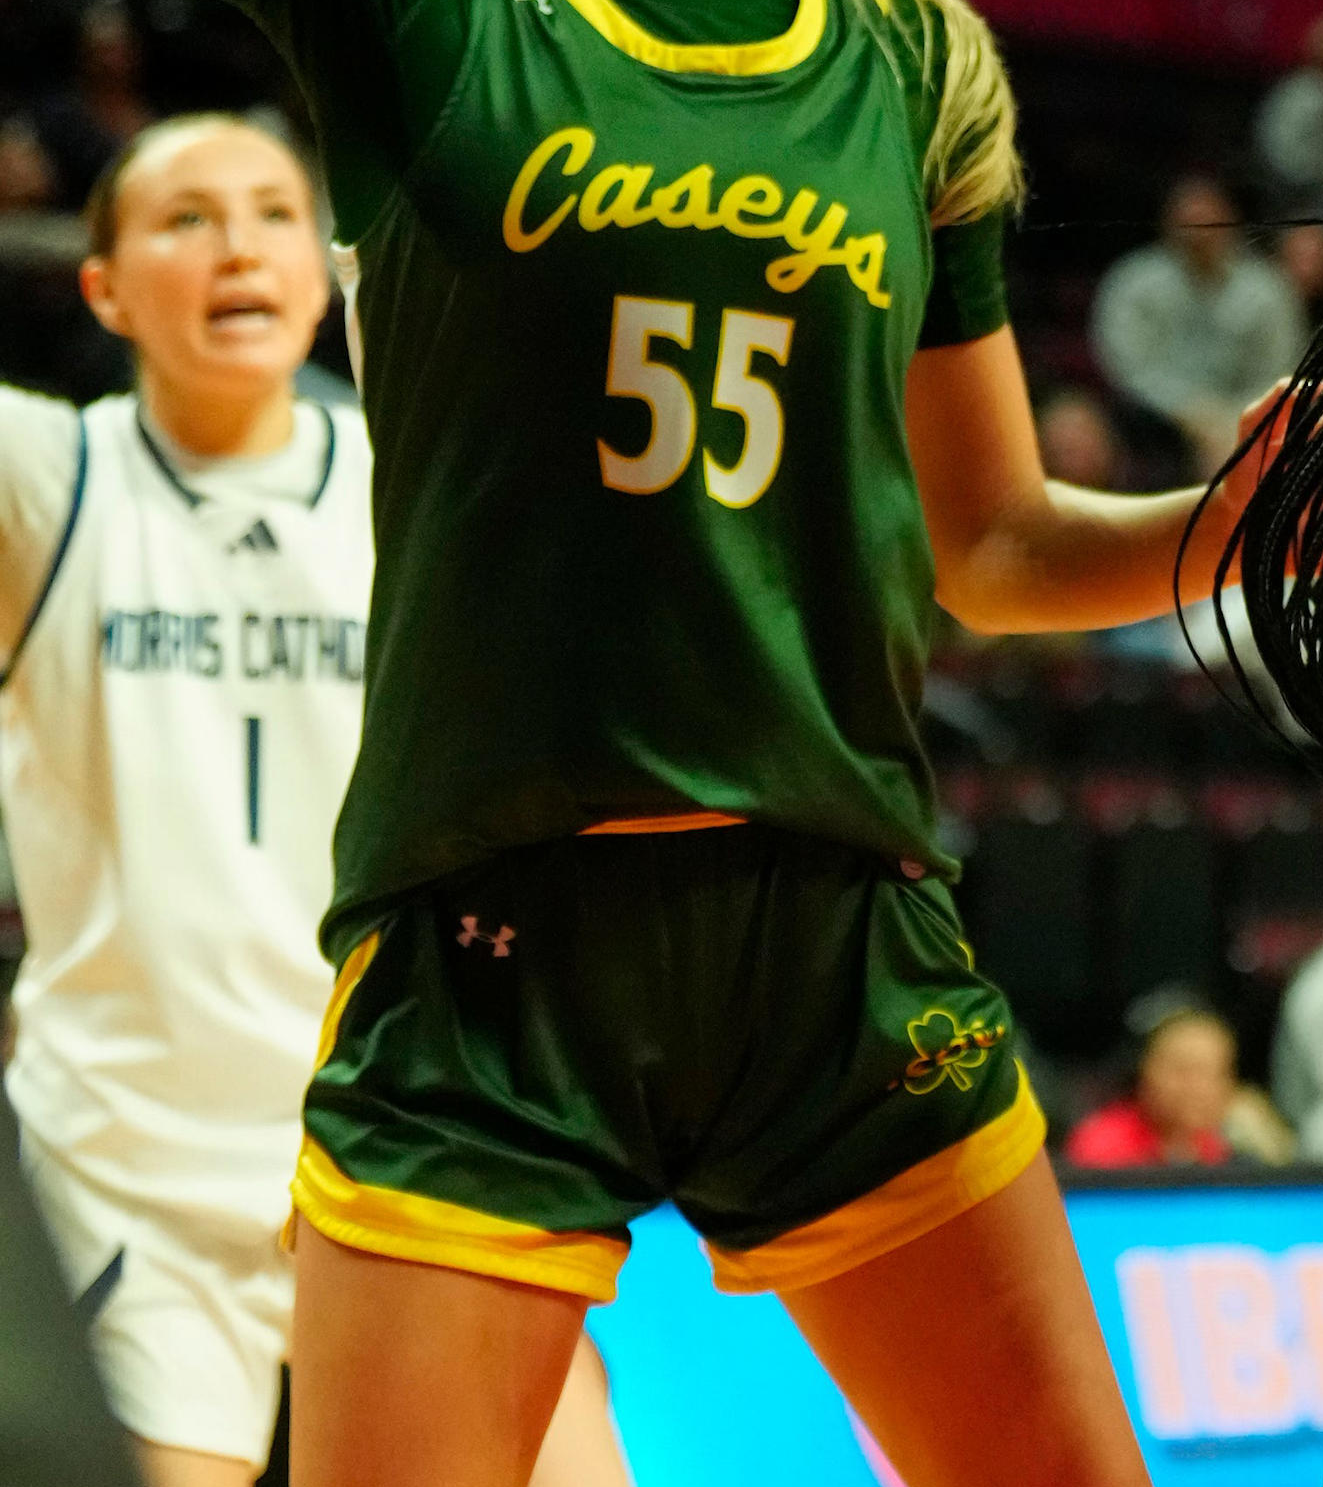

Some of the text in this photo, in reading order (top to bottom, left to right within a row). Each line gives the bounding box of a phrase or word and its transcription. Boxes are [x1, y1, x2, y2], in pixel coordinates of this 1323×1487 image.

[502, 126, 891, 309] Caseys
[597, 293, 795, 510] 55
[243, 716, 261, 847] 1
